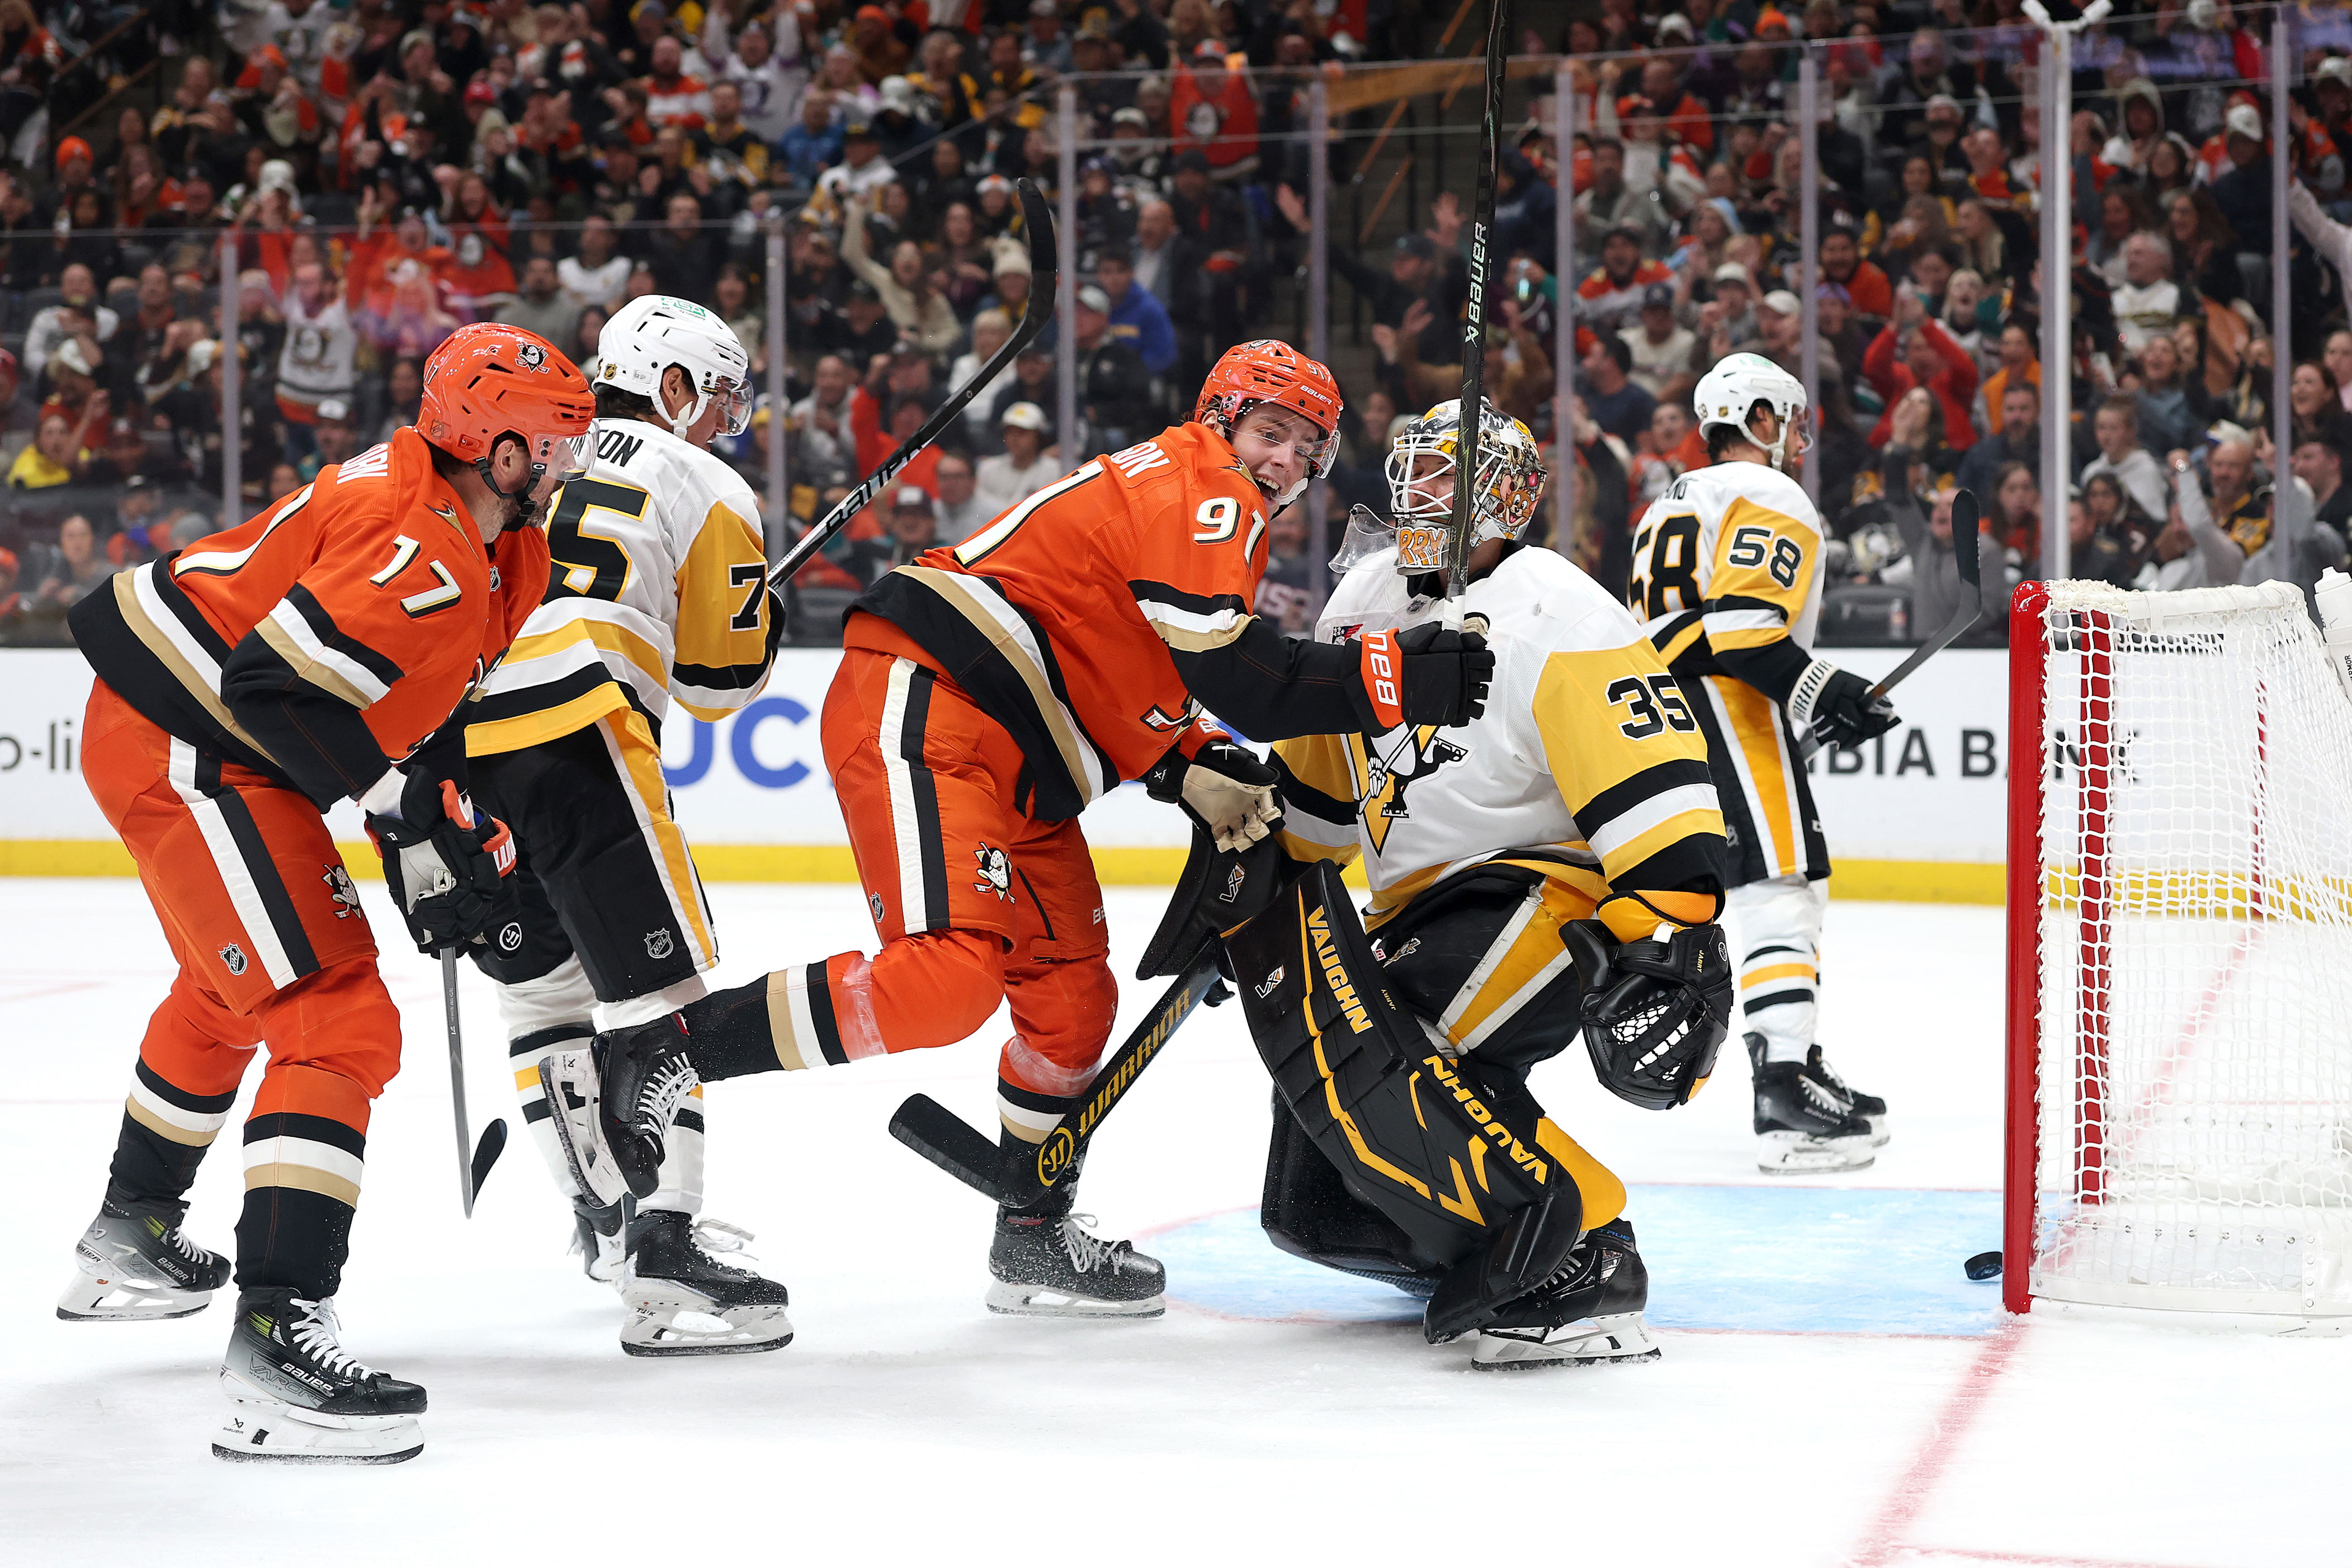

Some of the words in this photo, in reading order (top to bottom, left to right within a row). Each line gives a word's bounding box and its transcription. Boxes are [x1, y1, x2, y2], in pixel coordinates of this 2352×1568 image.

[1193, 497, 1266, 570] 91
[1727, 525, 1804, 591] 58
[369, 535, 462, 618] 17
[729, 561, 768, 632] 7
[1604, 672, 1697, 742] 35
[1812, 729, 1935, 776] BIA
[1307, 905, 1373, 1035] VAUGHN
[1696, 950, 1704, 974] JARRY
[1381, 988, 1396, 1011] JARRY
[1079, 988, 1191, 1137] WARRIOR
[1422, 1054, 1548, 1185] VAUGHN
[1598, 1228, 1632, 1241] TRUE
[251, 1353, 318, 1407] VAPOR
